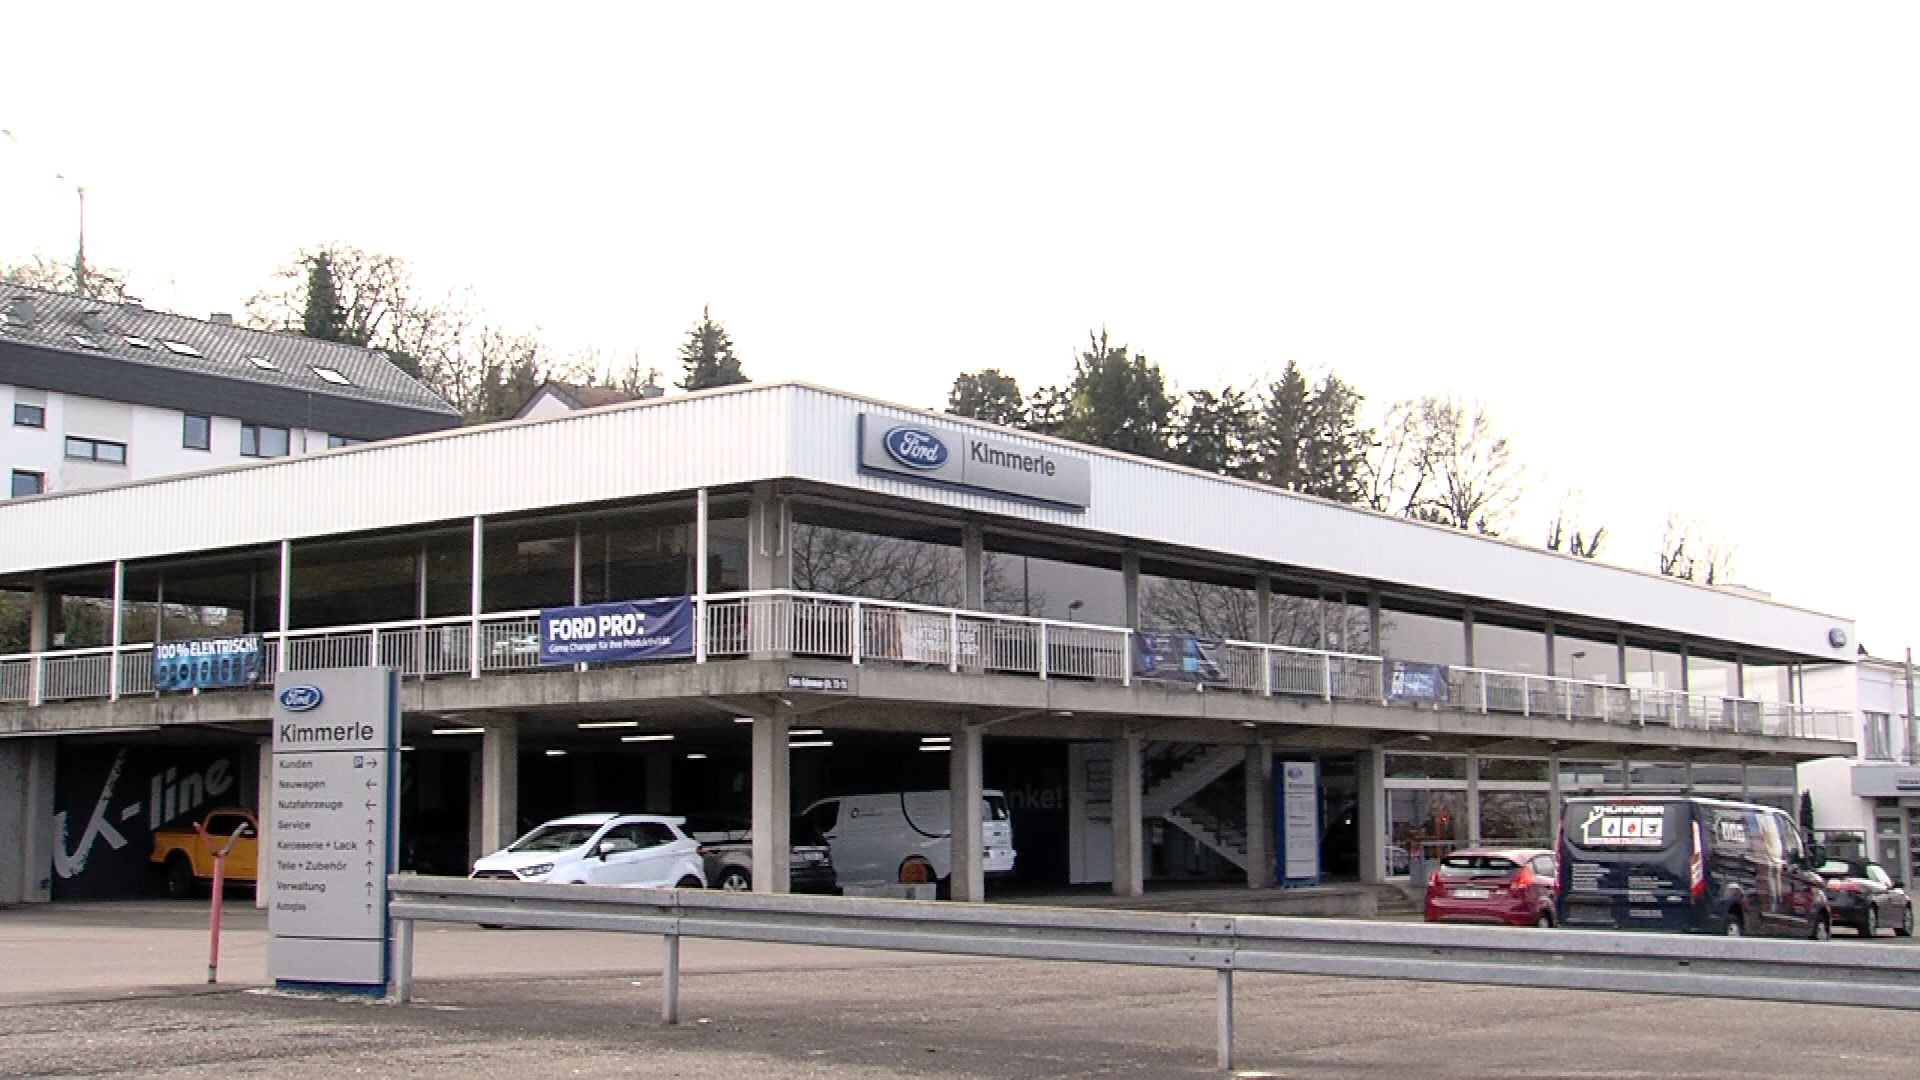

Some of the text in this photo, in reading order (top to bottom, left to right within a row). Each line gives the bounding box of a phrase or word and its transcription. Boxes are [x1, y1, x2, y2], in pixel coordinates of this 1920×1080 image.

[970, 439, 1056, 477] Kimmerle
[549, 617, 596, 641] FORD
[157, 637, 259, 659] 100% ELEKTRISCH!
[279, 721, 374, 743] Kimmerle
[279, 759, 313, 769] Kunden
[279, 780, 326, 791] Neuwagen
[278, 799, 344, 811] Nutzfahrzeuge
[278, 820, 311, 831] Service
[334, 841, 358, 851] Lack
[277, 860, 296, 871] Teile
[305, 861, 347, 871] Zubehör
[277, 881, 326, 893] Verwaltung
